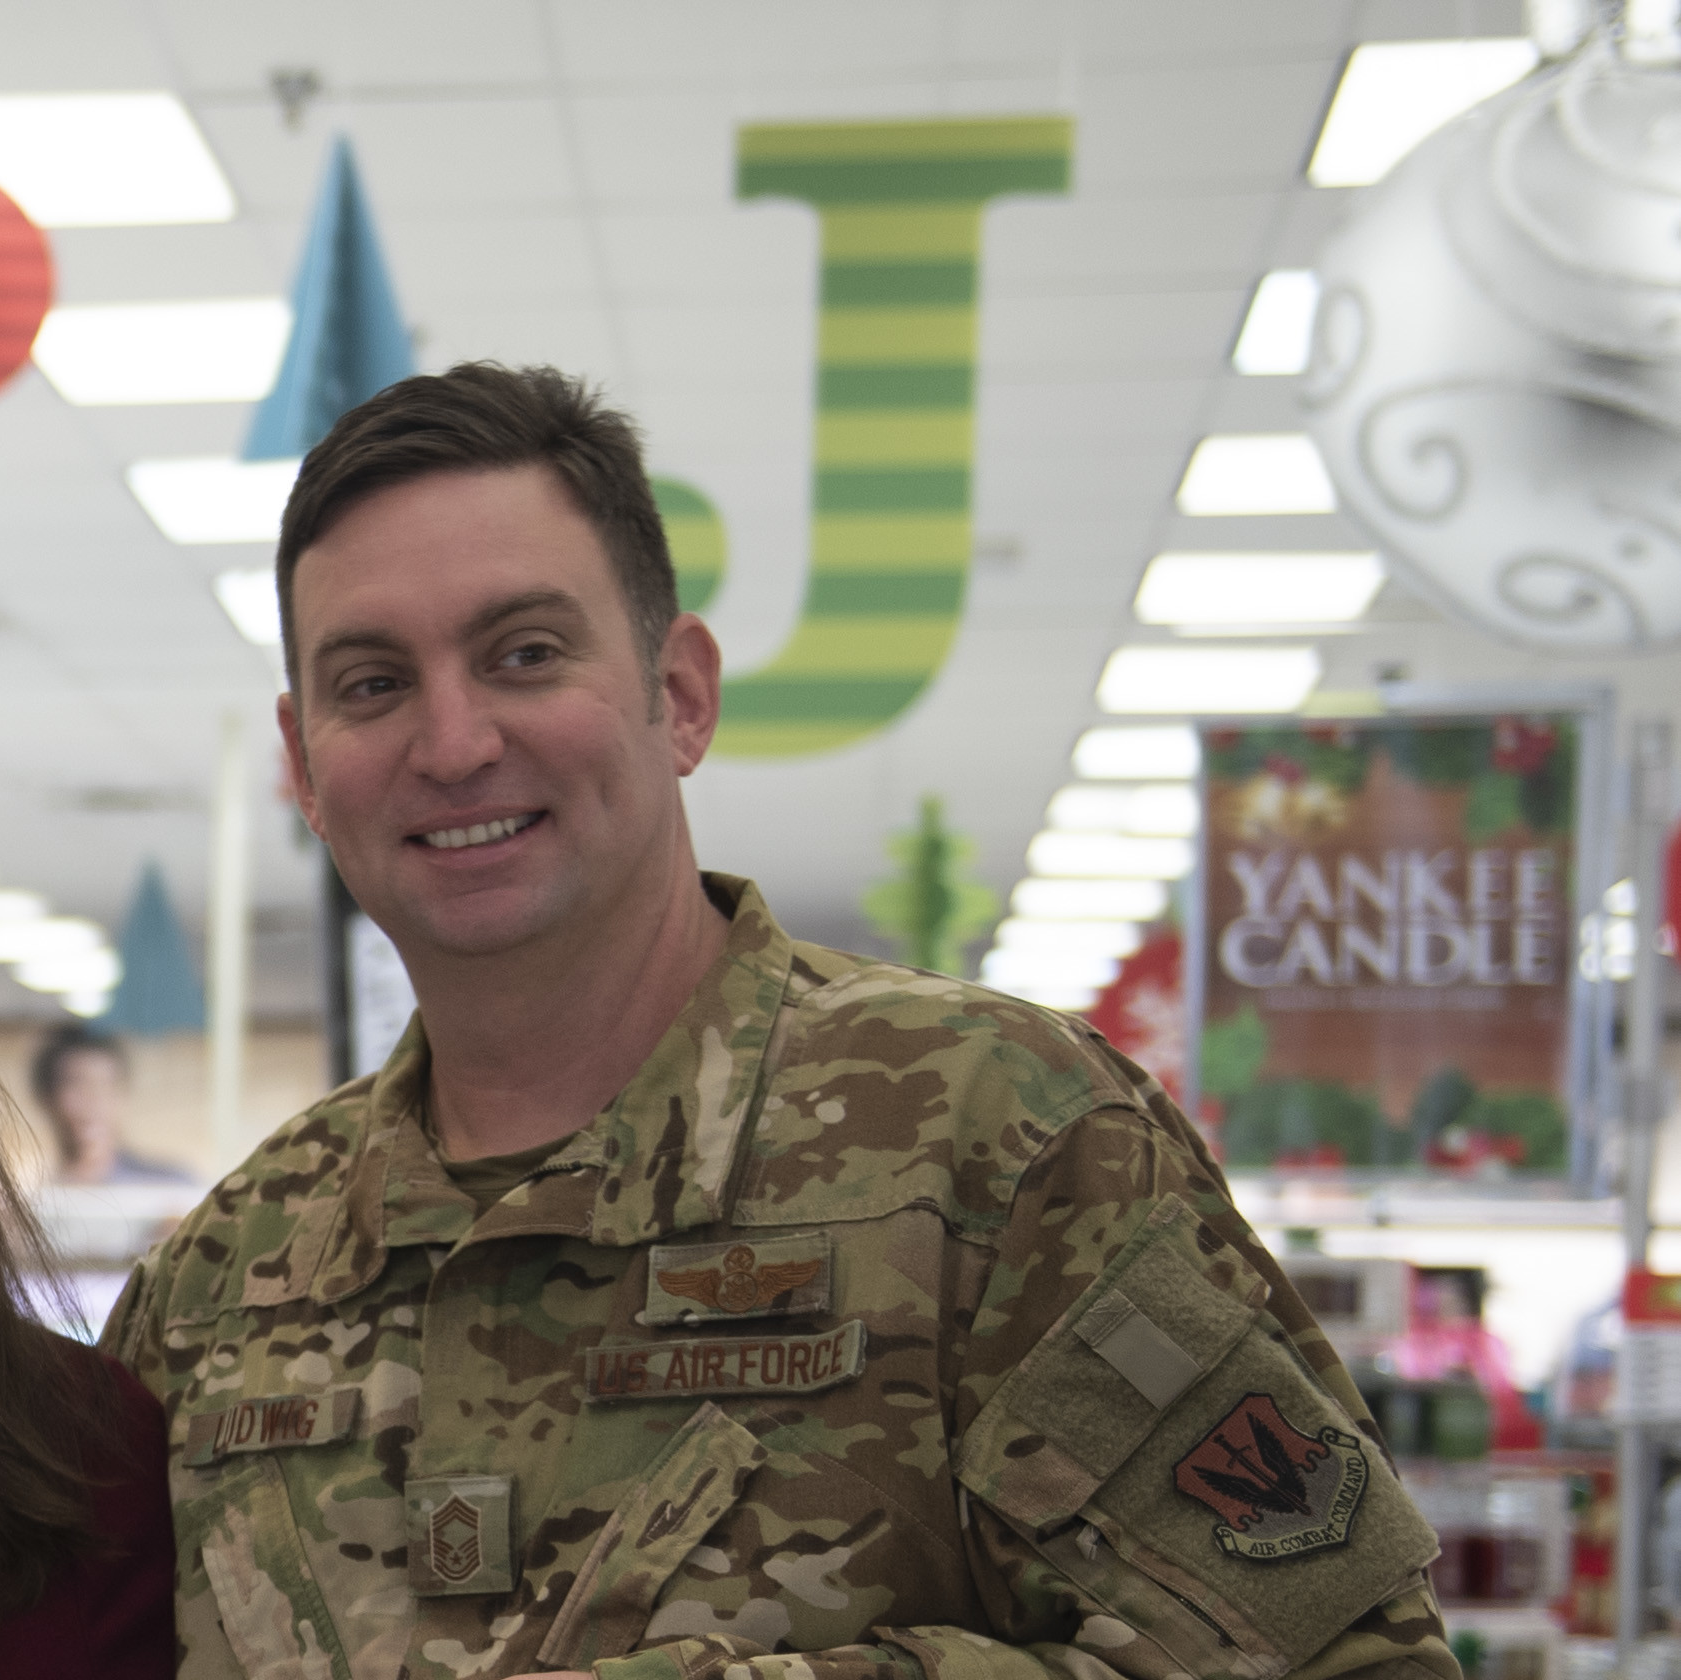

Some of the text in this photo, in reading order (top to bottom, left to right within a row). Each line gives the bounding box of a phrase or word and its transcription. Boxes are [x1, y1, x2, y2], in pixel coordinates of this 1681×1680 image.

[1230, 850, 1554, 921] YANKEE
[1218, 917, 1554, 988] CANDLE
[663, 1345, 725, 1390] AIR
[738, 1331, 845, 1386] FORCE
[212, 1400, 319, 1454] LUDWIG
[1249, 1457, 1364, 1556] AIR COMBAT COMMAND
